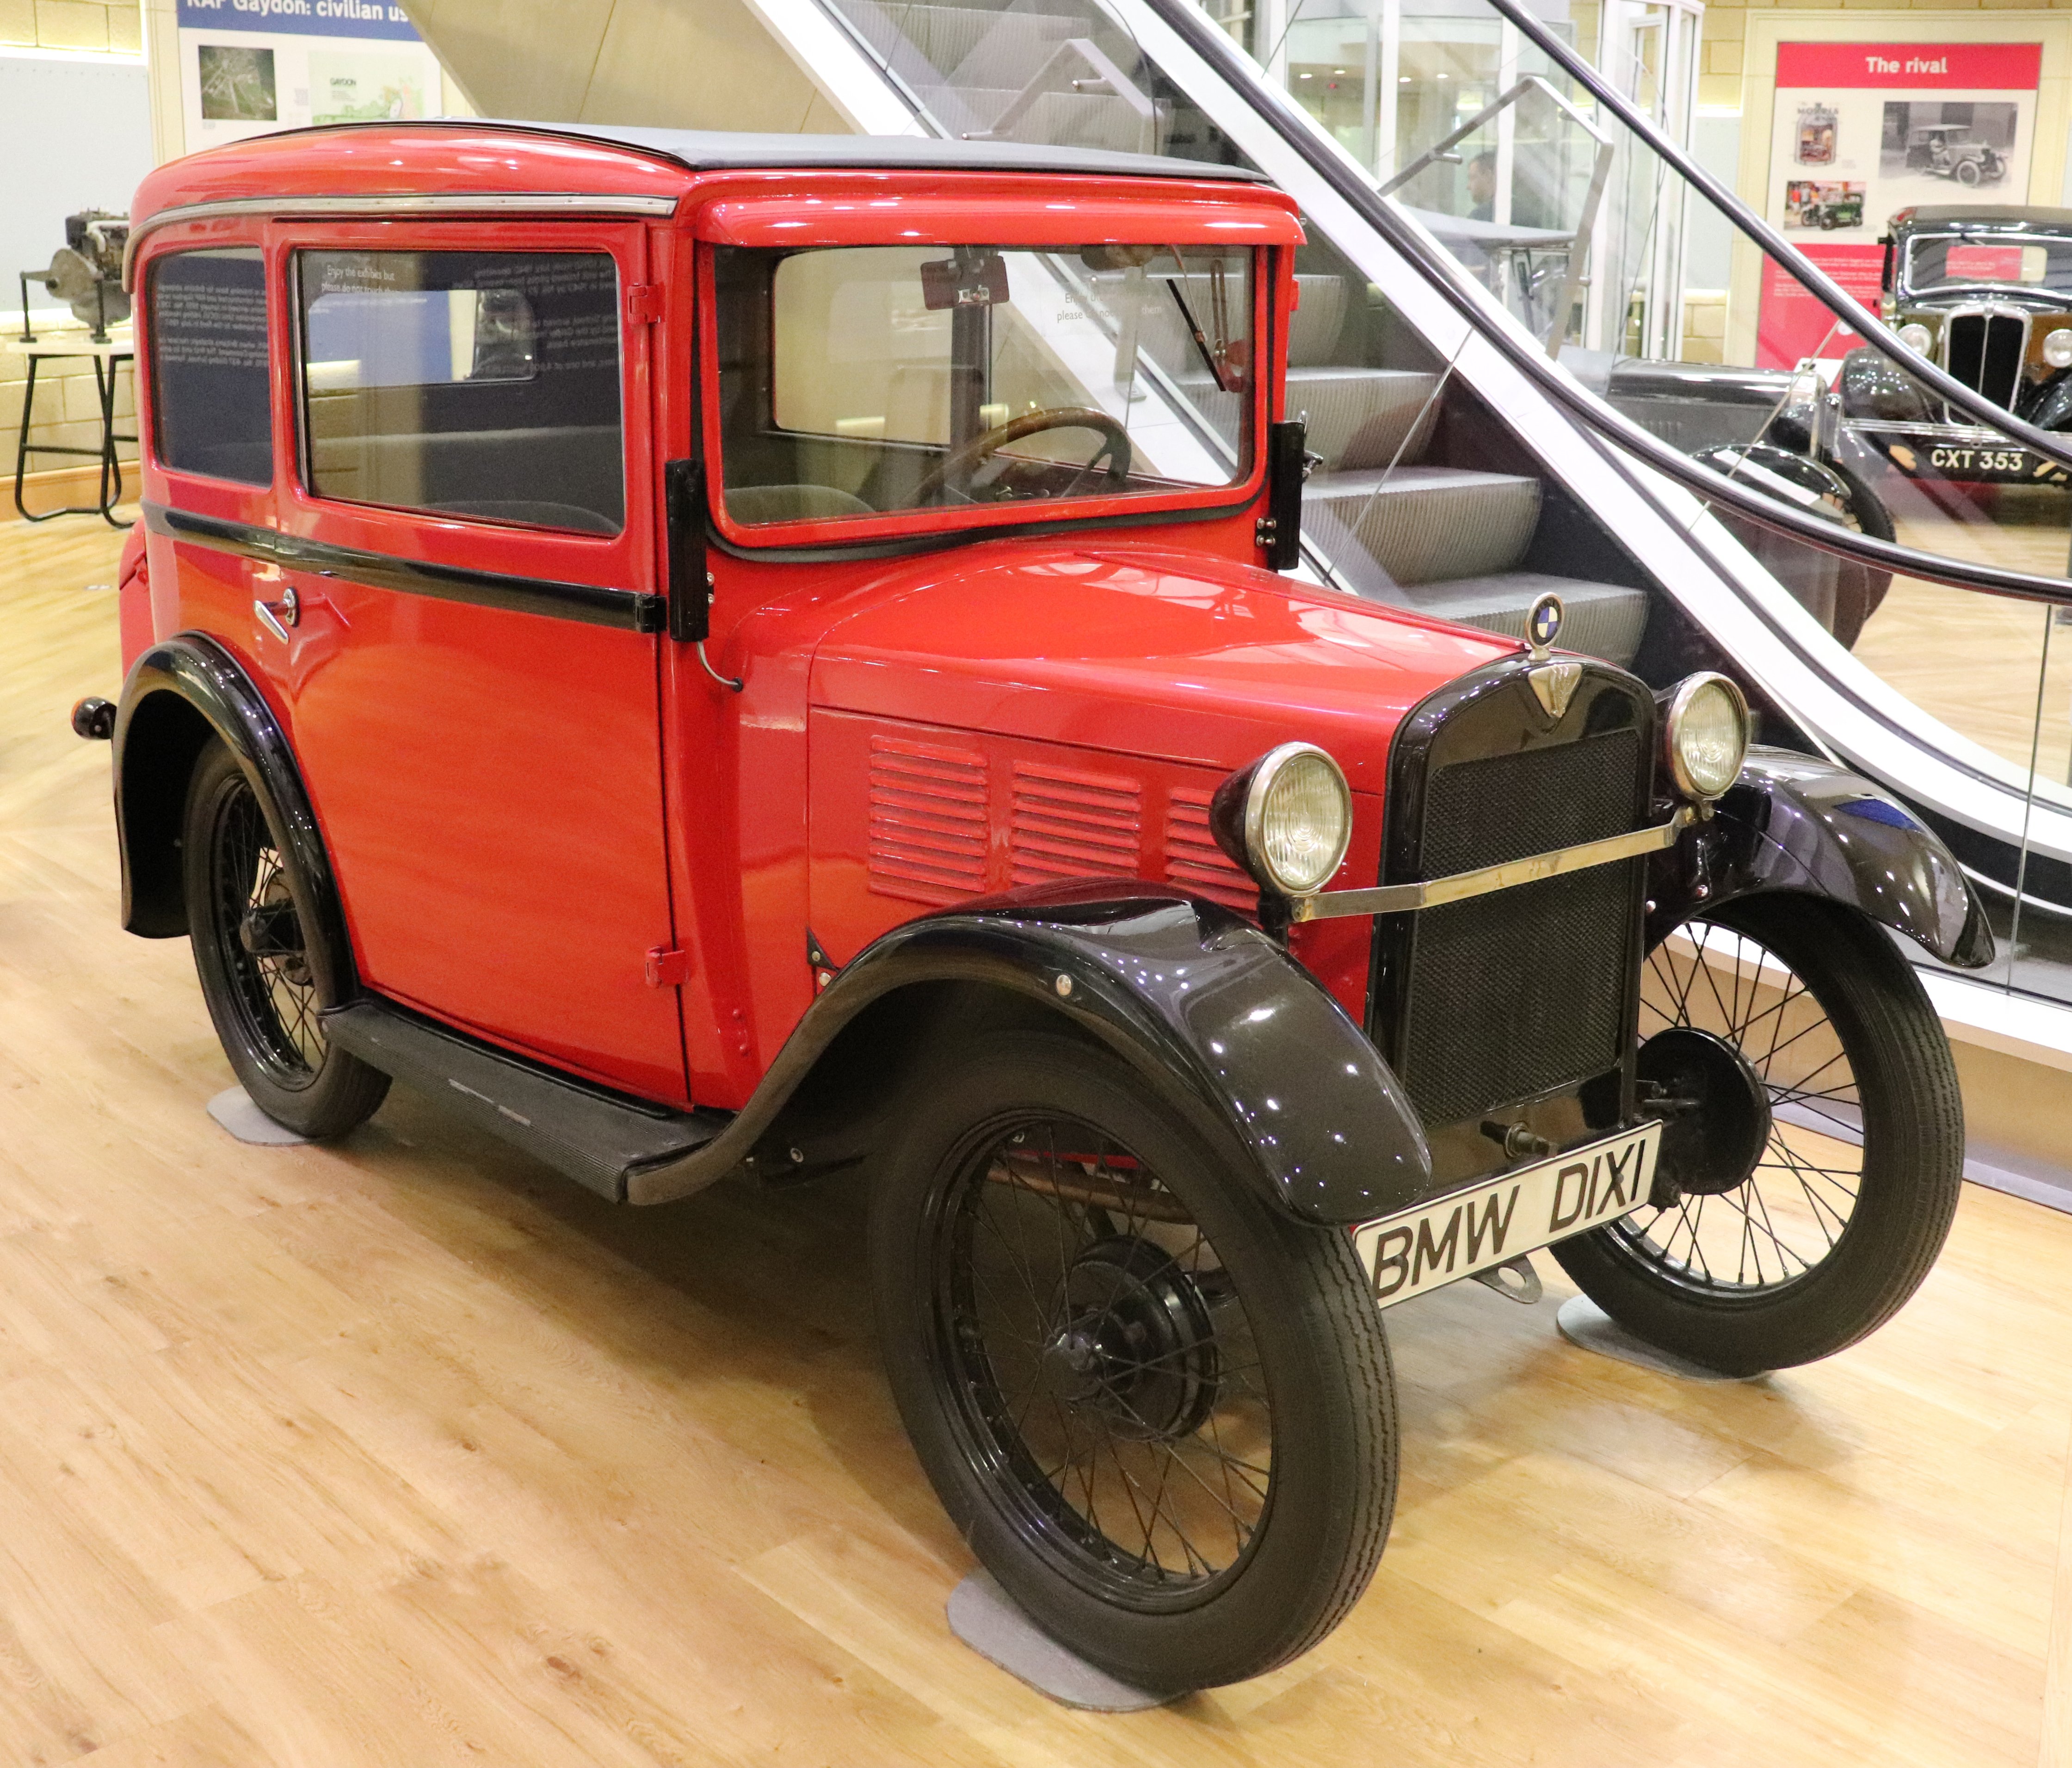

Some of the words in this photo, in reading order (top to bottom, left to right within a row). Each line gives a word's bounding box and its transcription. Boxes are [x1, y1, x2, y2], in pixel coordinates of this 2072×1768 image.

[316, 0, 383, 20] civilian
[1865, 56, 1900, 73] The
[1906, 56, 1948, 73] rival
[327, 265, 344, 278] Enjoy
[345, 266, 356, 277] the
[384, 270, 395, 281] but
[321, 281, 340, 293] please
[1057, 310, 1083, 323] please
[1931, 449, 1975, 469] CXT
[1979, 451, 2023, 471] 353
[1372, 1185, 1521, 1299] BMW
[1549, 1138, 1646, 1233] DIXI
